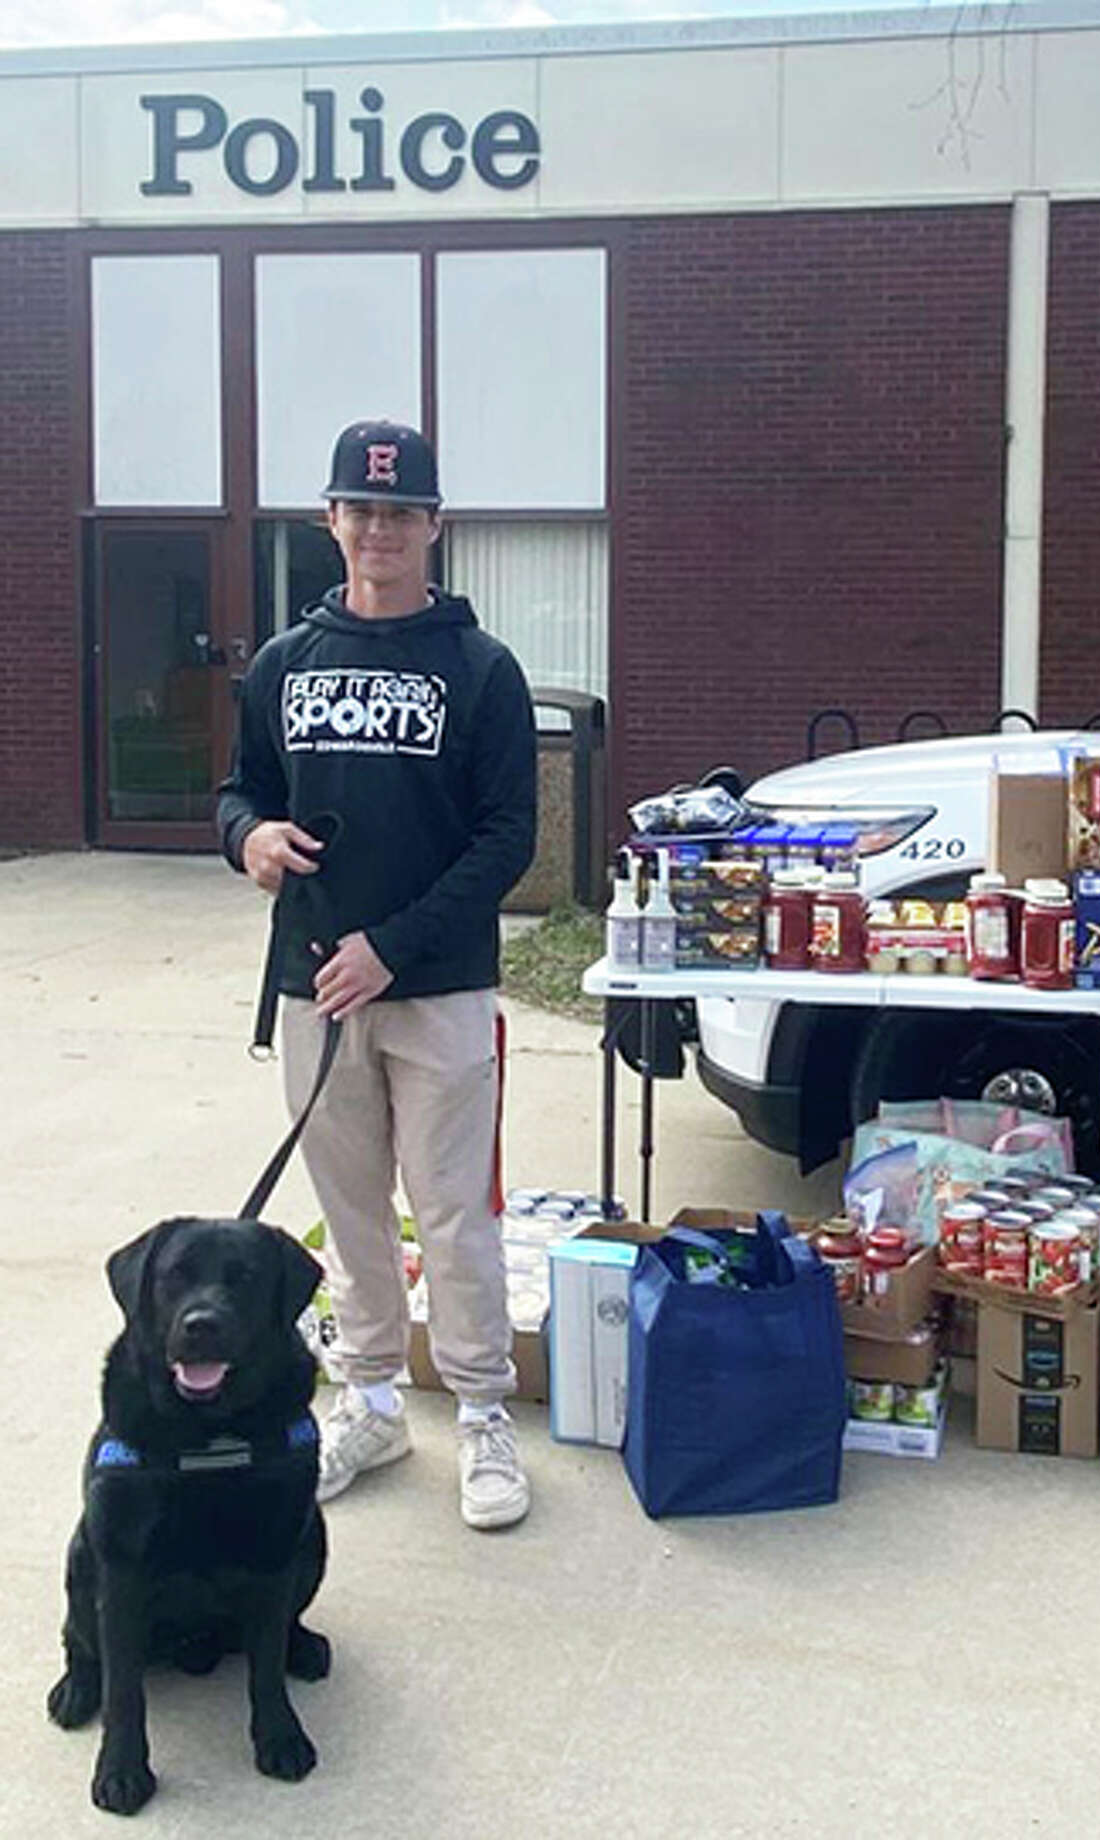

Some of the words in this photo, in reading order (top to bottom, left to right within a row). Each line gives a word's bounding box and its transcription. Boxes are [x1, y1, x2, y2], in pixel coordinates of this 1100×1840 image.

[139, 87, 540, 196] Police
[366, 444, 398, 485] E
[346, 677, 368, 697] IT
[287, 696, 437, 742] SPORTS
[900, 838, 965, 859] 420
